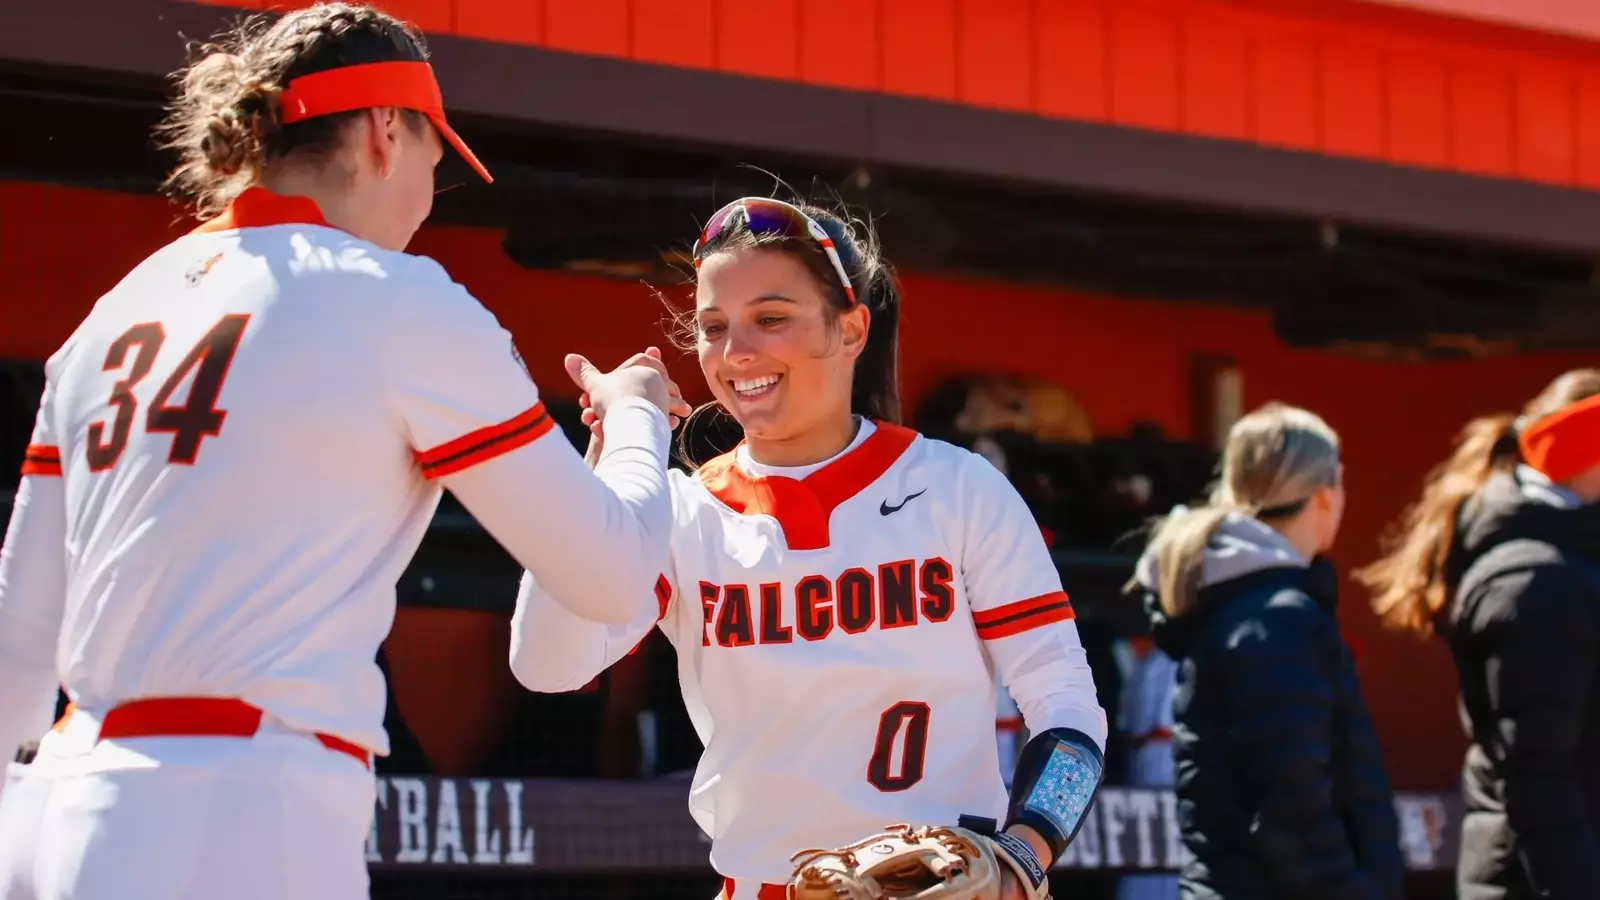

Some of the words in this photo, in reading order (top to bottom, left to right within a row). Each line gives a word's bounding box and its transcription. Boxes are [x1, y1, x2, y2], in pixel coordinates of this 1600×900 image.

[86, 313, 252, 473] 34
[698, 556, 955, 648] FALCONS
[866, 700, 931, 792] 0
